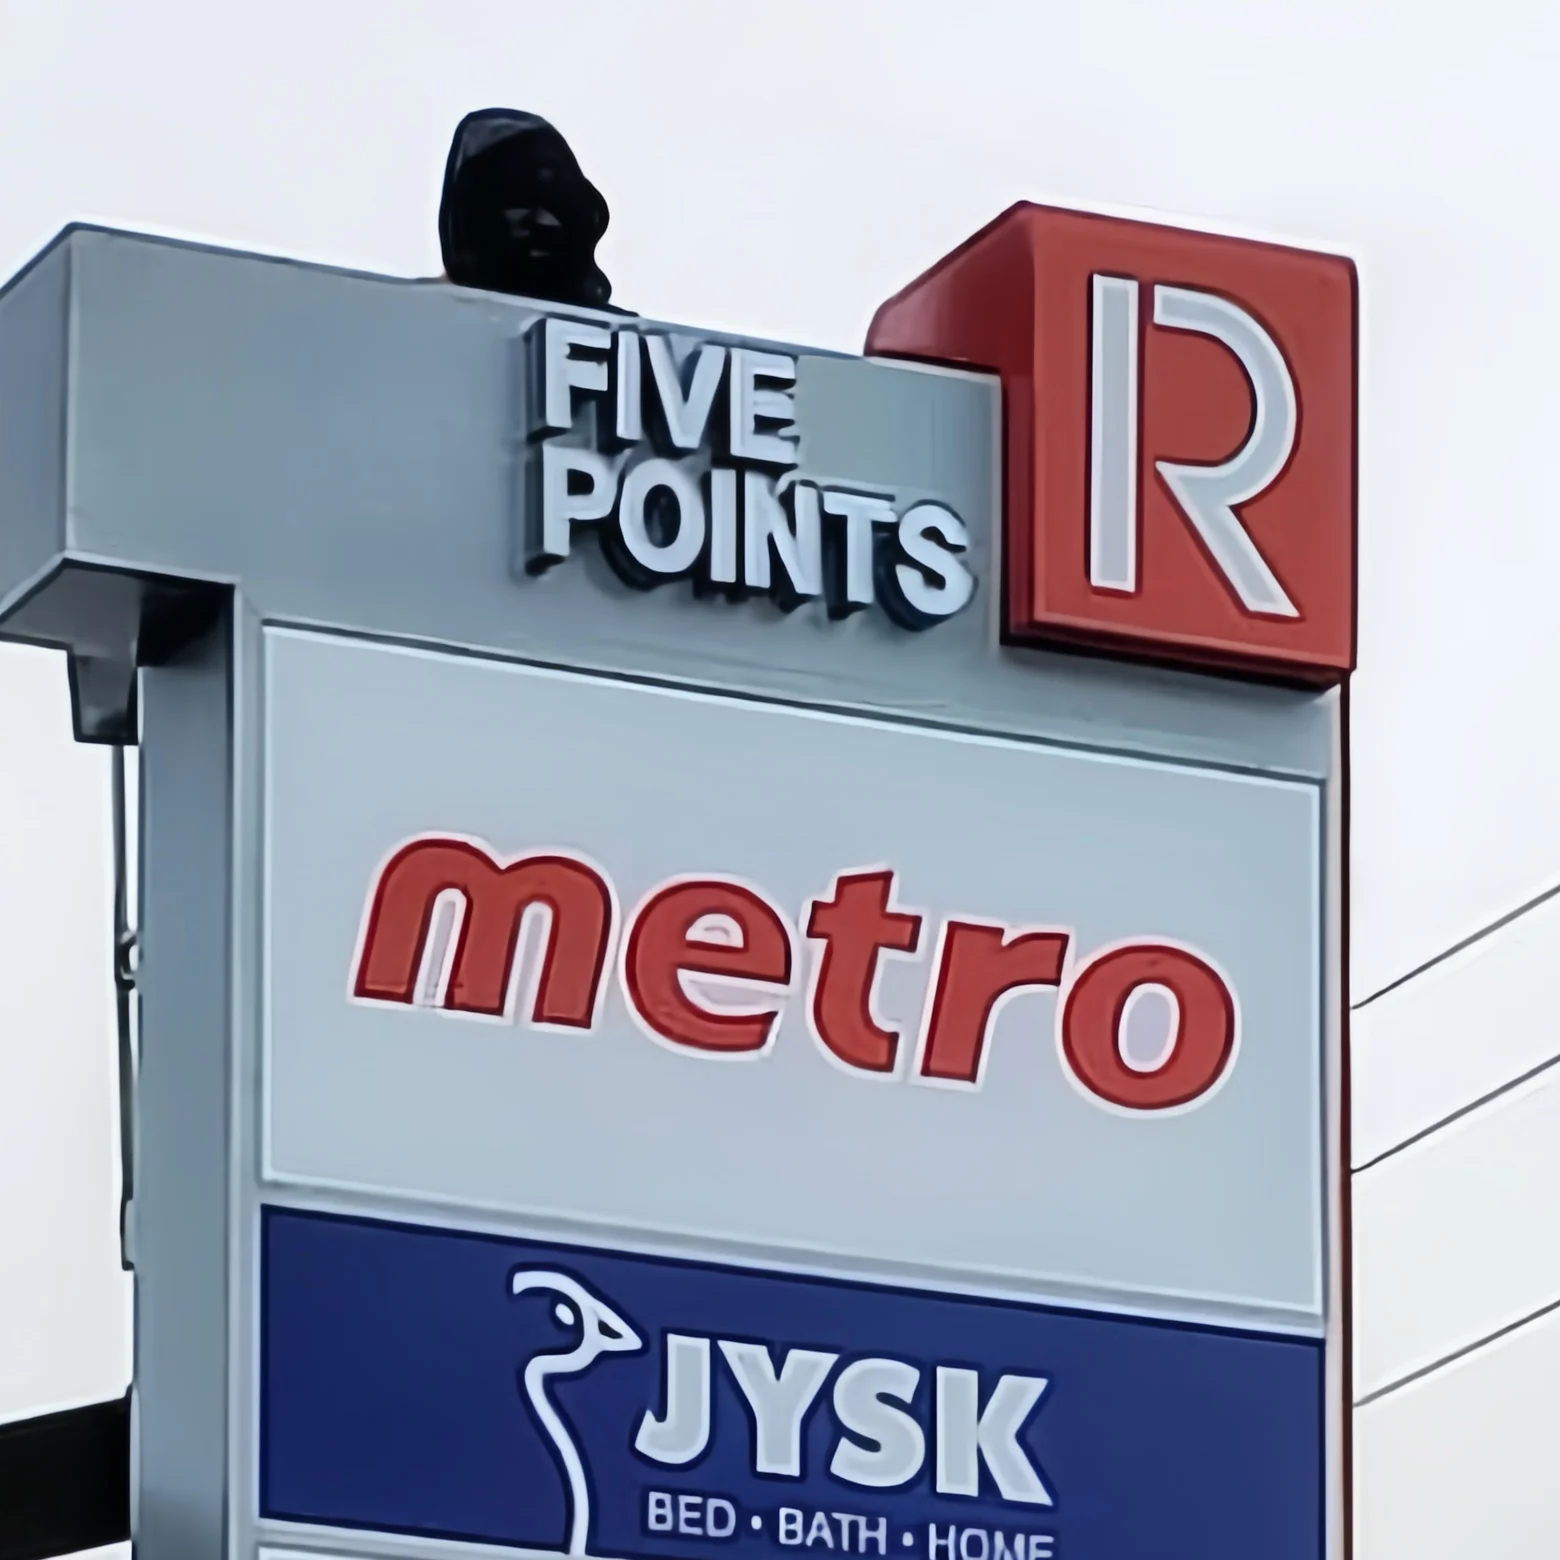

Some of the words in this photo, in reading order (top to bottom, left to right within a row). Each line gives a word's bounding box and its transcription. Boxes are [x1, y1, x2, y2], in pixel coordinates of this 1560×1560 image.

[541, 315, 801, 466] FIVE
[1088, 272, 1301, 620] R
[541, 450, 976, 617] POINTS
[354, 838, 1236, 1111] metro
[635, 1332, 1052, 1507] JYSK
[647, 1491, 736, 1539] BED
[777, 1507, 887, 1555] BATH
